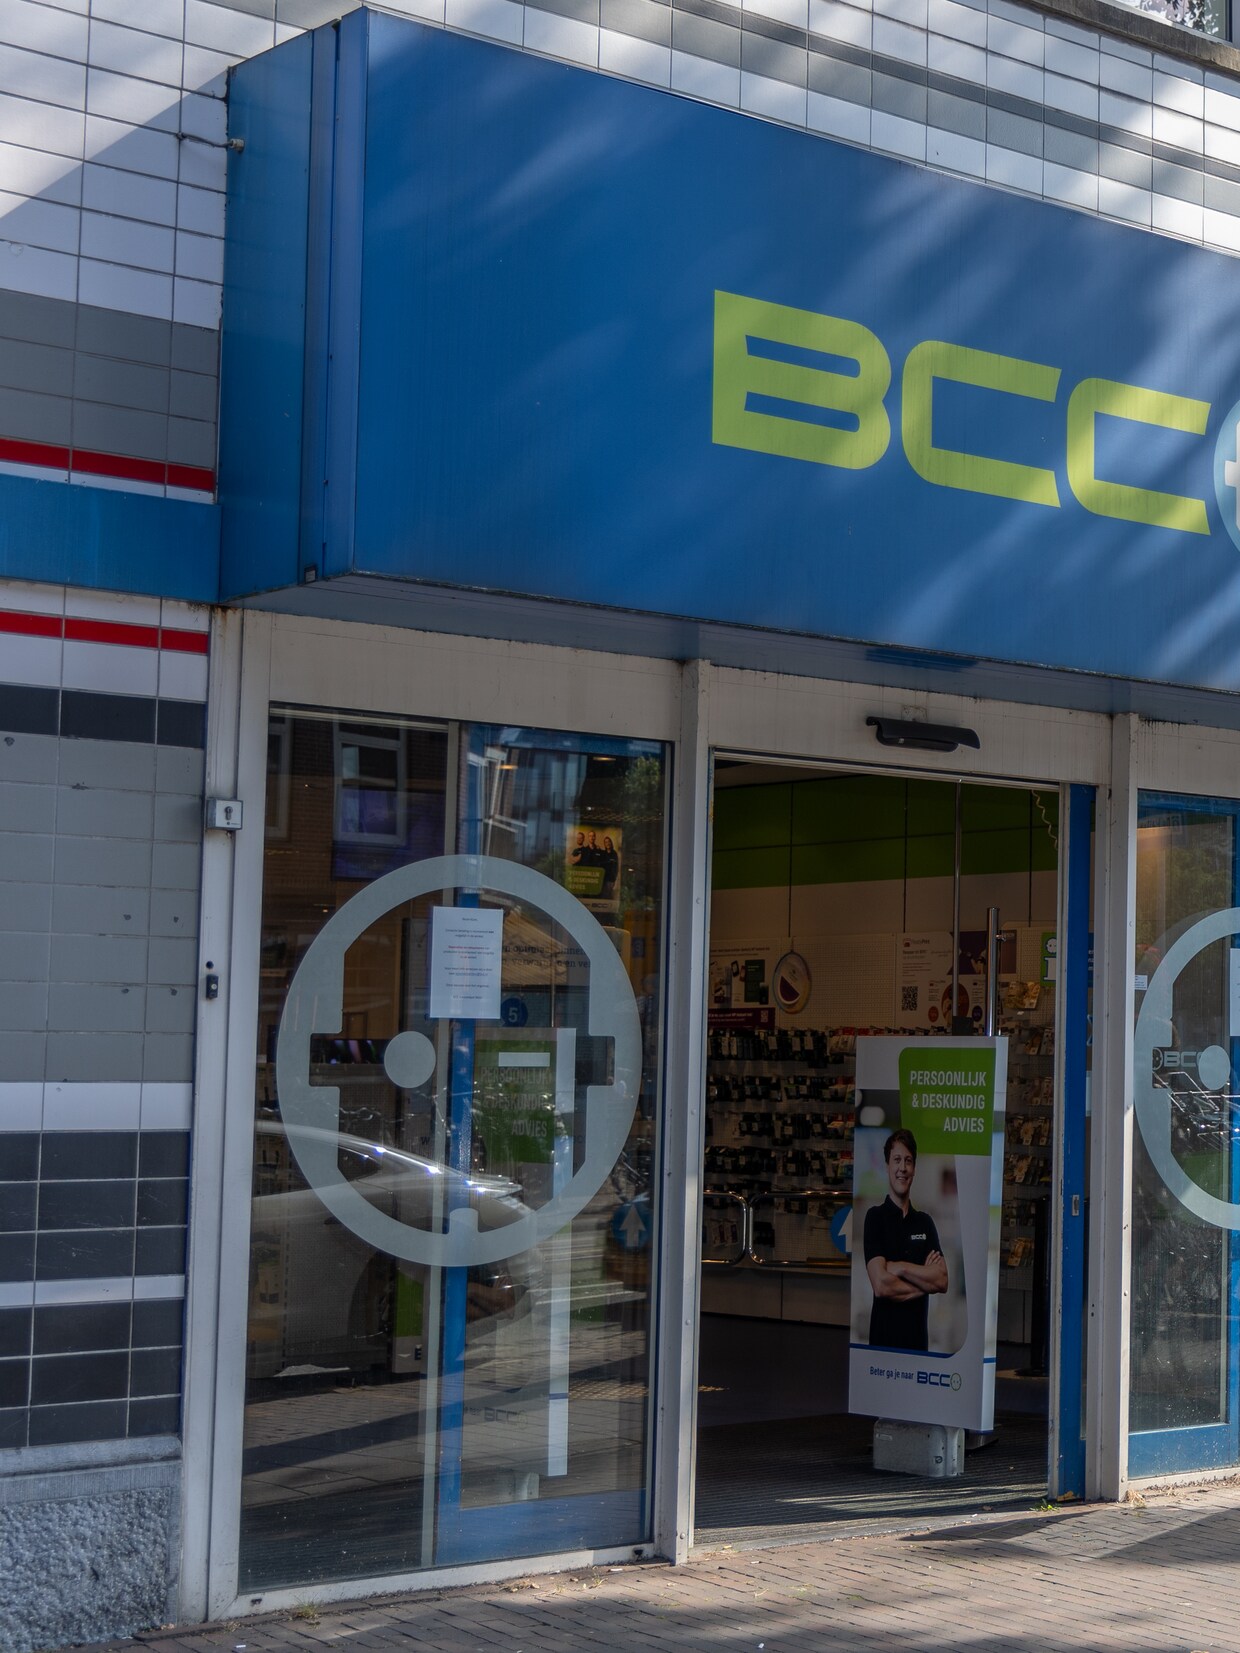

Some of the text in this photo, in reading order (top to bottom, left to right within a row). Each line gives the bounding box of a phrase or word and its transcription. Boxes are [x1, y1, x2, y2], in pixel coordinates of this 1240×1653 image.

[712, 290, 1212, 537] BCC
[508, 1007, 518, 1022] 5
[910, 1070, 987, 1086] PERSOONLIJK
[912, 1093, 985, 1109] & DESKUNDIG
[511, 1119, 548, 1137] ADVIES
[943, 1117, 985, 1133] ADVIES
[870, 1366, 950, 1387] Beter ga je naar BCC
